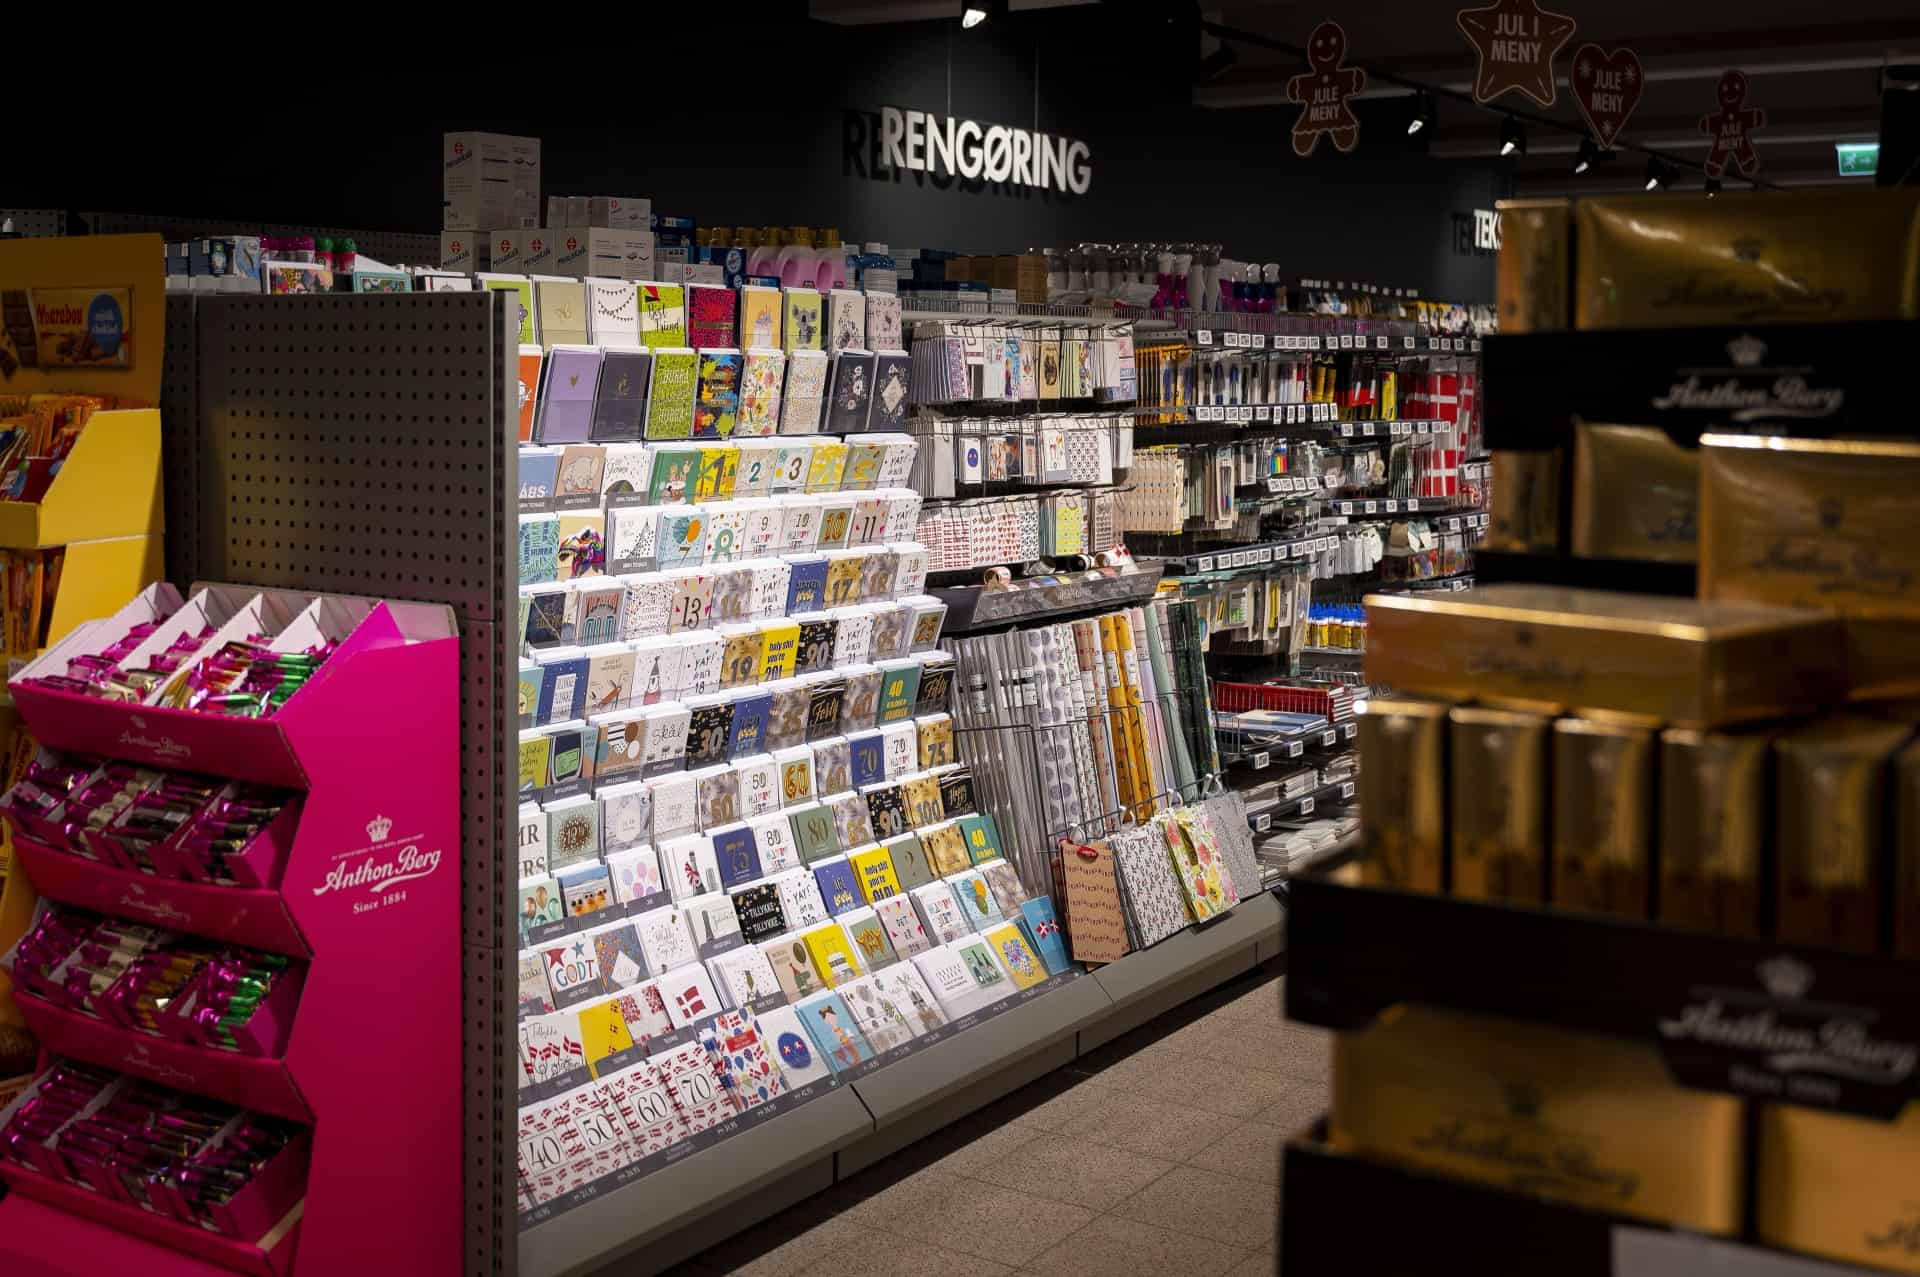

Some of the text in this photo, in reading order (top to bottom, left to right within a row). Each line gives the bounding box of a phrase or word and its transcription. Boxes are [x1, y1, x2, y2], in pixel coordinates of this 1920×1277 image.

[1494, 14, 1540, 39] JUL I
[1491, 40, 1543, 65] MENY
[1593, 70, 1623, 92] JULE
[1313, 86, 1341, 105] JULE
[1592, 93, 1625, 113] MENY
[1309, 104, 1342, 121] MENY
[881, 105, 1091, 195] RENGØRING
[748, 461, 761, 483] 2
[788, 457, 802, 481] 3
[760, 517, 768, 531] 9
[796, 513, 810, 528] 10
[824, 511, 847, 542] 10
[860, 516, 876, 543] 11
[832, 578, 854, 607] 17
[681, 596, 702, 629] 13
[732, 655, 754, 685] 19
[695, 681, 705, 696] 18
[888, 679, 904, 697] 40
[700, 724, 724, 759] 30
[893, 739, 907, 755] 70
[858, 748, 879, 775] 70
[927, 743, 947, 768] 75
[752, 773, 767, 790] 50
[783, 764, 809, 800] 60
[710, 794, 735, 821] 50
[917, 799, 944, 827] 100
[807, 816, 829, 843] 80
[878, 808, 903, 838] 90
[766, 829, 782, 848] 80
[970, 828, 986, 848] 40
[519, 856, 546, 879] RS
[725, 841, 750, 872] 75
[312, 857, 394, 897] Anthon
[394, 844, 442, 882] Berg
[352, 889, 407, 915] Since 1884
[555, 958, 595, 988] GODT
[681, 1071, 712, 1107] 70
[637, 1090, 669, 1123] 60
[583, 1112, 616, 1147] 50
[529, 1136, 562, 1170] 40
